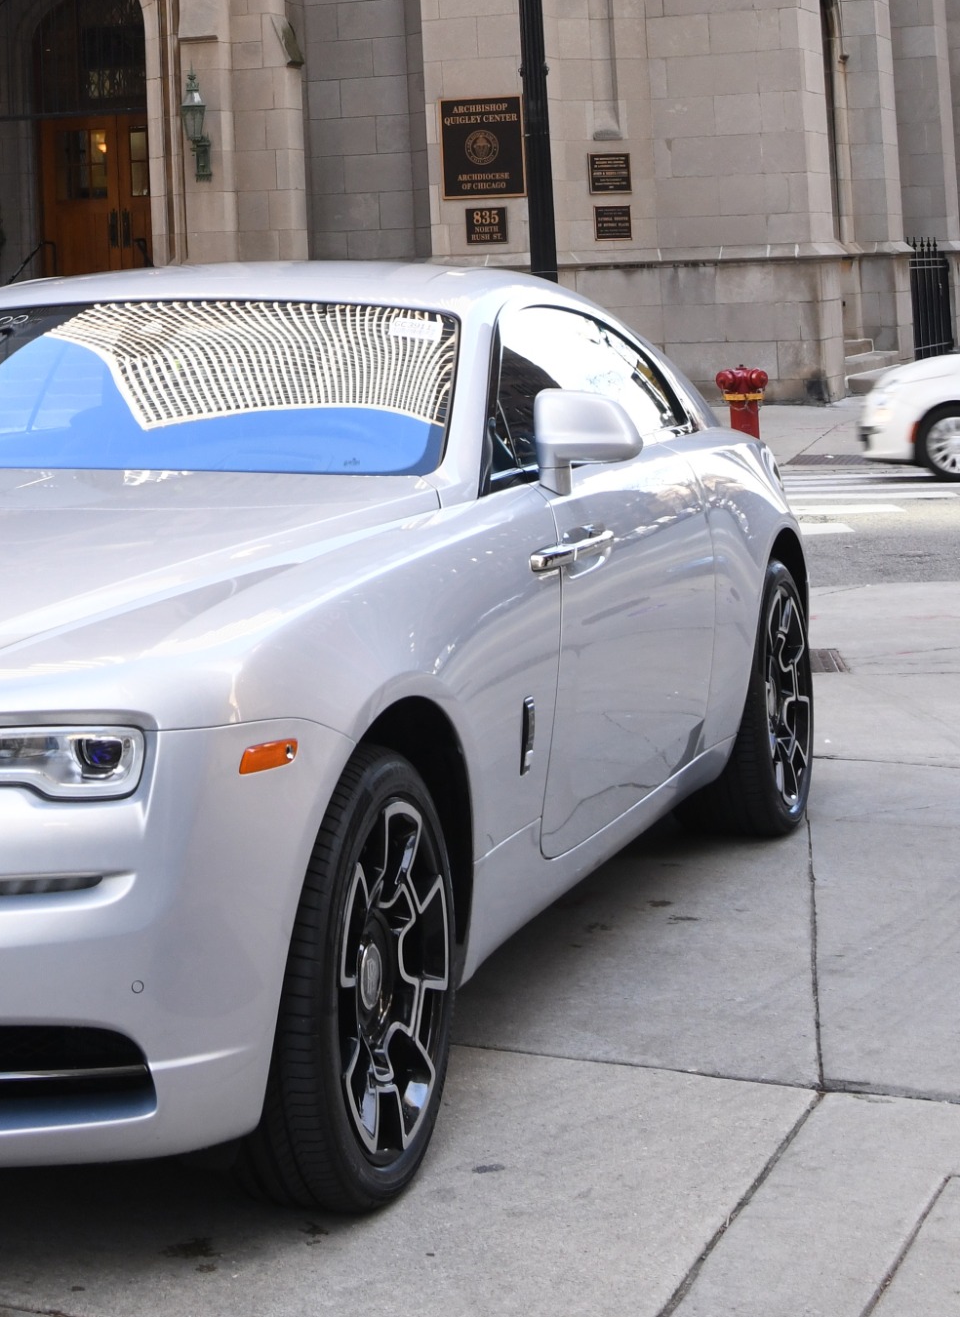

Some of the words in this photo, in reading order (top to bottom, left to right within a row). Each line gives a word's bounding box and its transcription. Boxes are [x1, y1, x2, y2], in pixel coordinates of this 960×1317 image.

[452, 103, 508, 114] ARCHBISHOP
[444, 115, 481, 126] QUIGLEY
[483, 113, 518, 123] CENTER
[457, 172, 510, 181] ARCHDIOCESE
[473, 181, 506, 190] CHICAGO
[473, 210, 499, 225] 835
[474, 225, 499, 233] NORTH
[471, 233, 490, 241] RUSH
